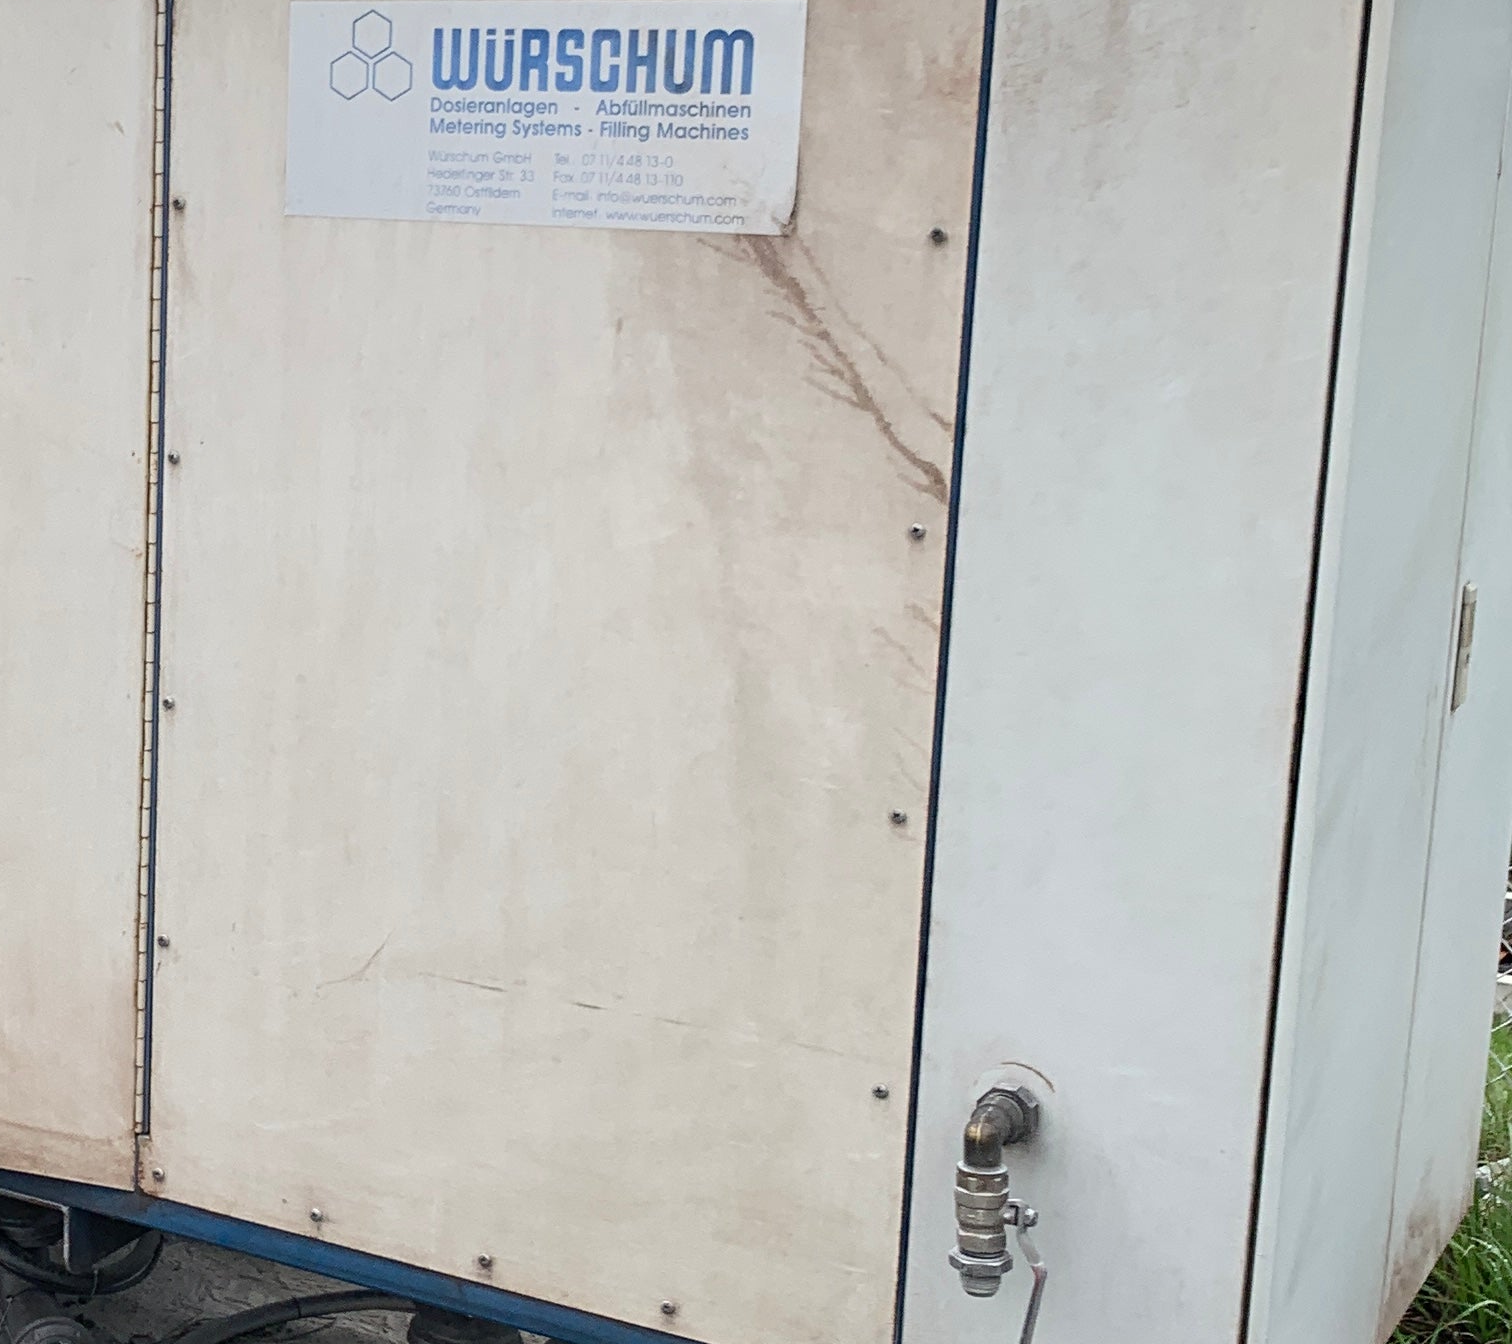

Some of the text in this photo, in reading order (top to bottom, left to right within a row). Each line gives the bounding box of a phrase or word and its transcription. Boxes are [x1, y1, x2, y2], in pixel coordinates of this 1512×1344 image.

[432, 28, 755, 95] WÜRSCHUM
[430, 97, 558, 118] Dosieranlagen
[595, 99, 752, 118] Abfüllmaschinen
[429, 118, 506, 138] Metering
[512, 119, 582, 138] Systems
[600, 121, 650, 142] Filling
[656, 122, 749, 140] Machines
[493, 151, 532, 164] GmbH
[520, 169, 535, 182] 33
[426, 201, 481, 216] Germany
